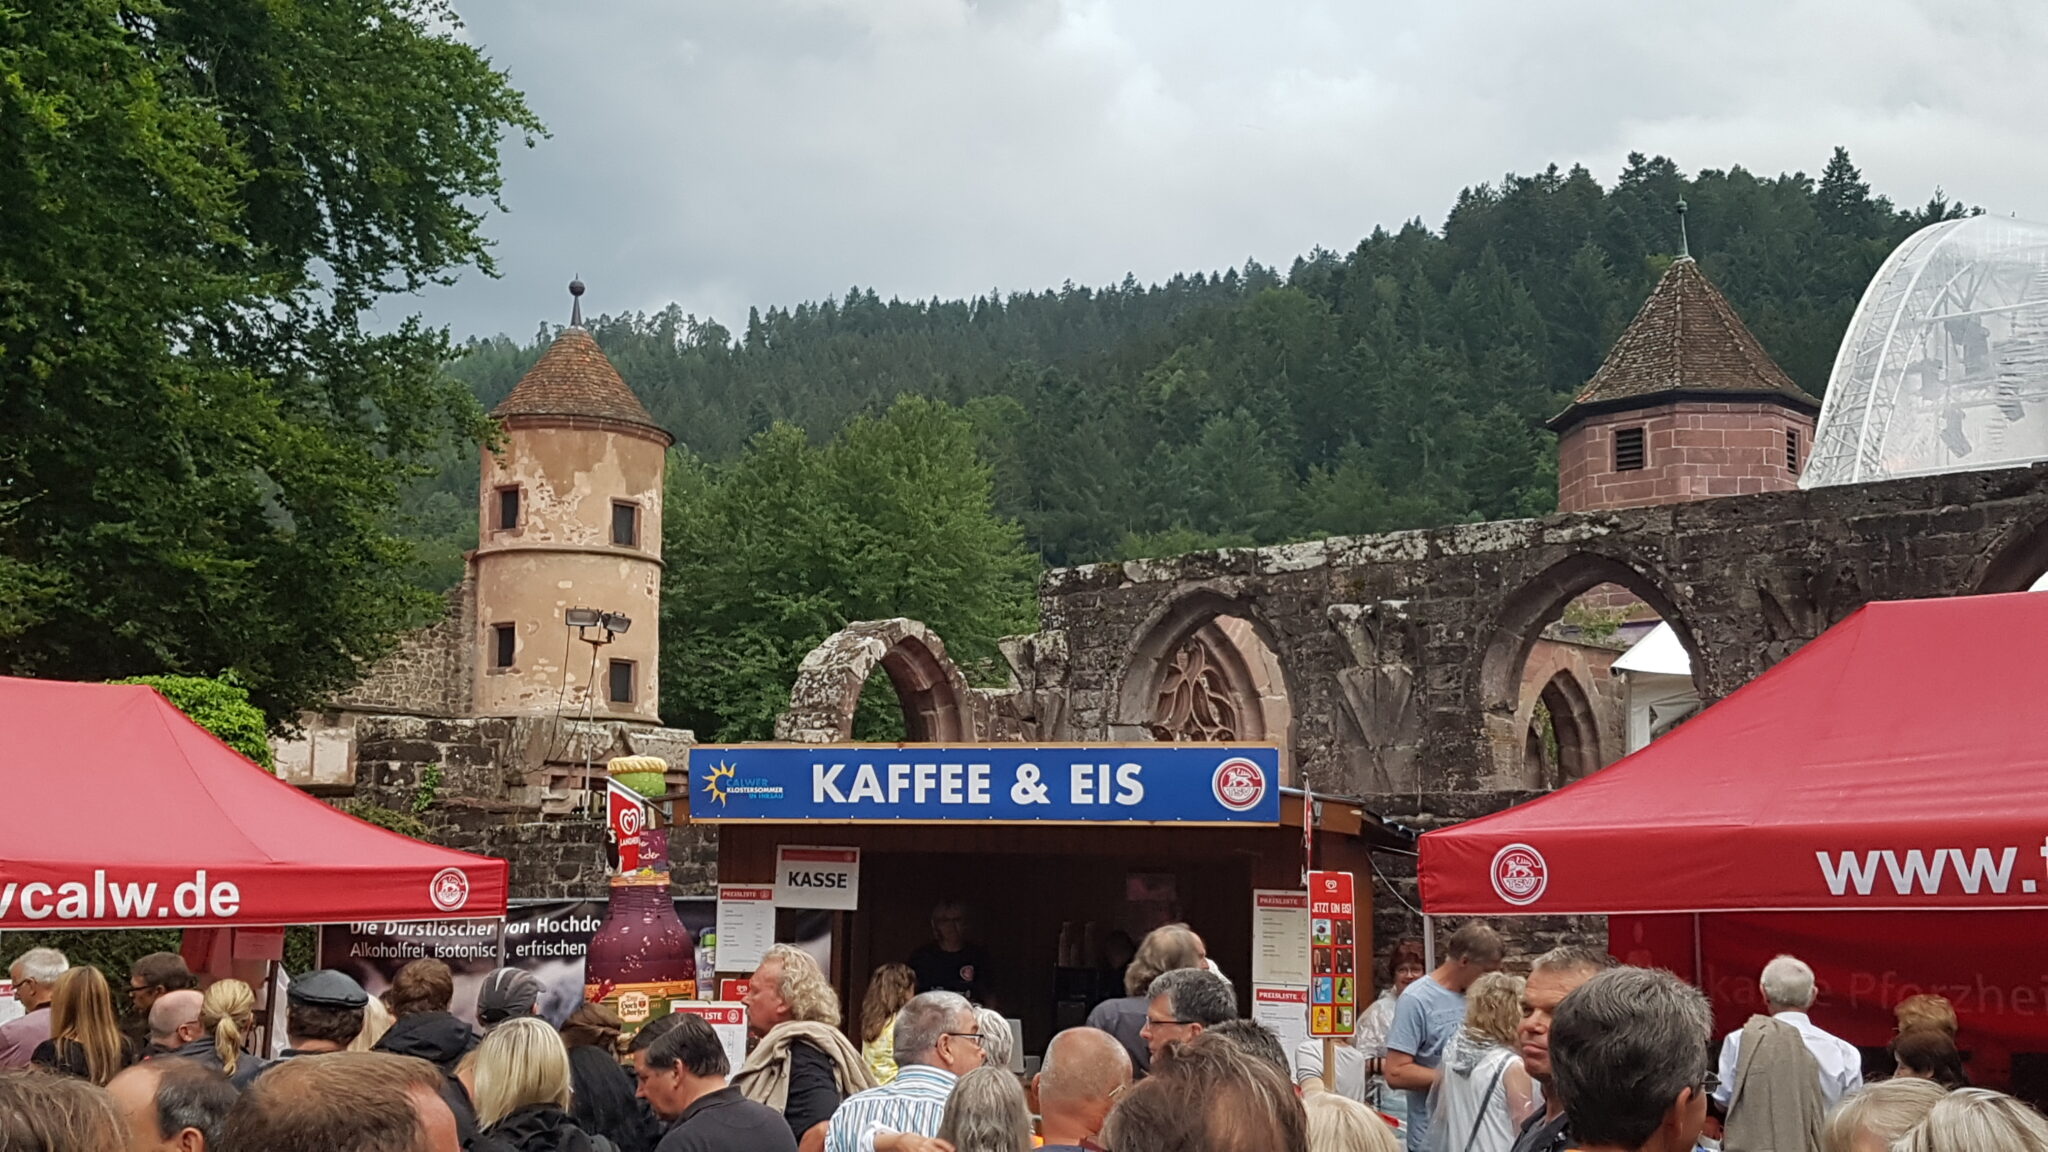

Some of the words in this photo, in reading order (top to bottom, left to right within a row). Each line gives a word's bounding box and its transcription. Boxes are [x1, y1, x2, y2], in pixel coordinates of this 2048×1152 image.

[726, 778, 768, 787] CALWER
[812, 763, 991, 804] KAFFEE
[1010, 762, 1051, 805] &
[1070, 763, 1144, 805] EIS
[788, 871, 848, 889] KASSE
[1506, 878, 1533, 889] TSV
[384, 919, 495, 936] Durstlöscher
[1258, 991, 1298, 1000] PREISLISTE
